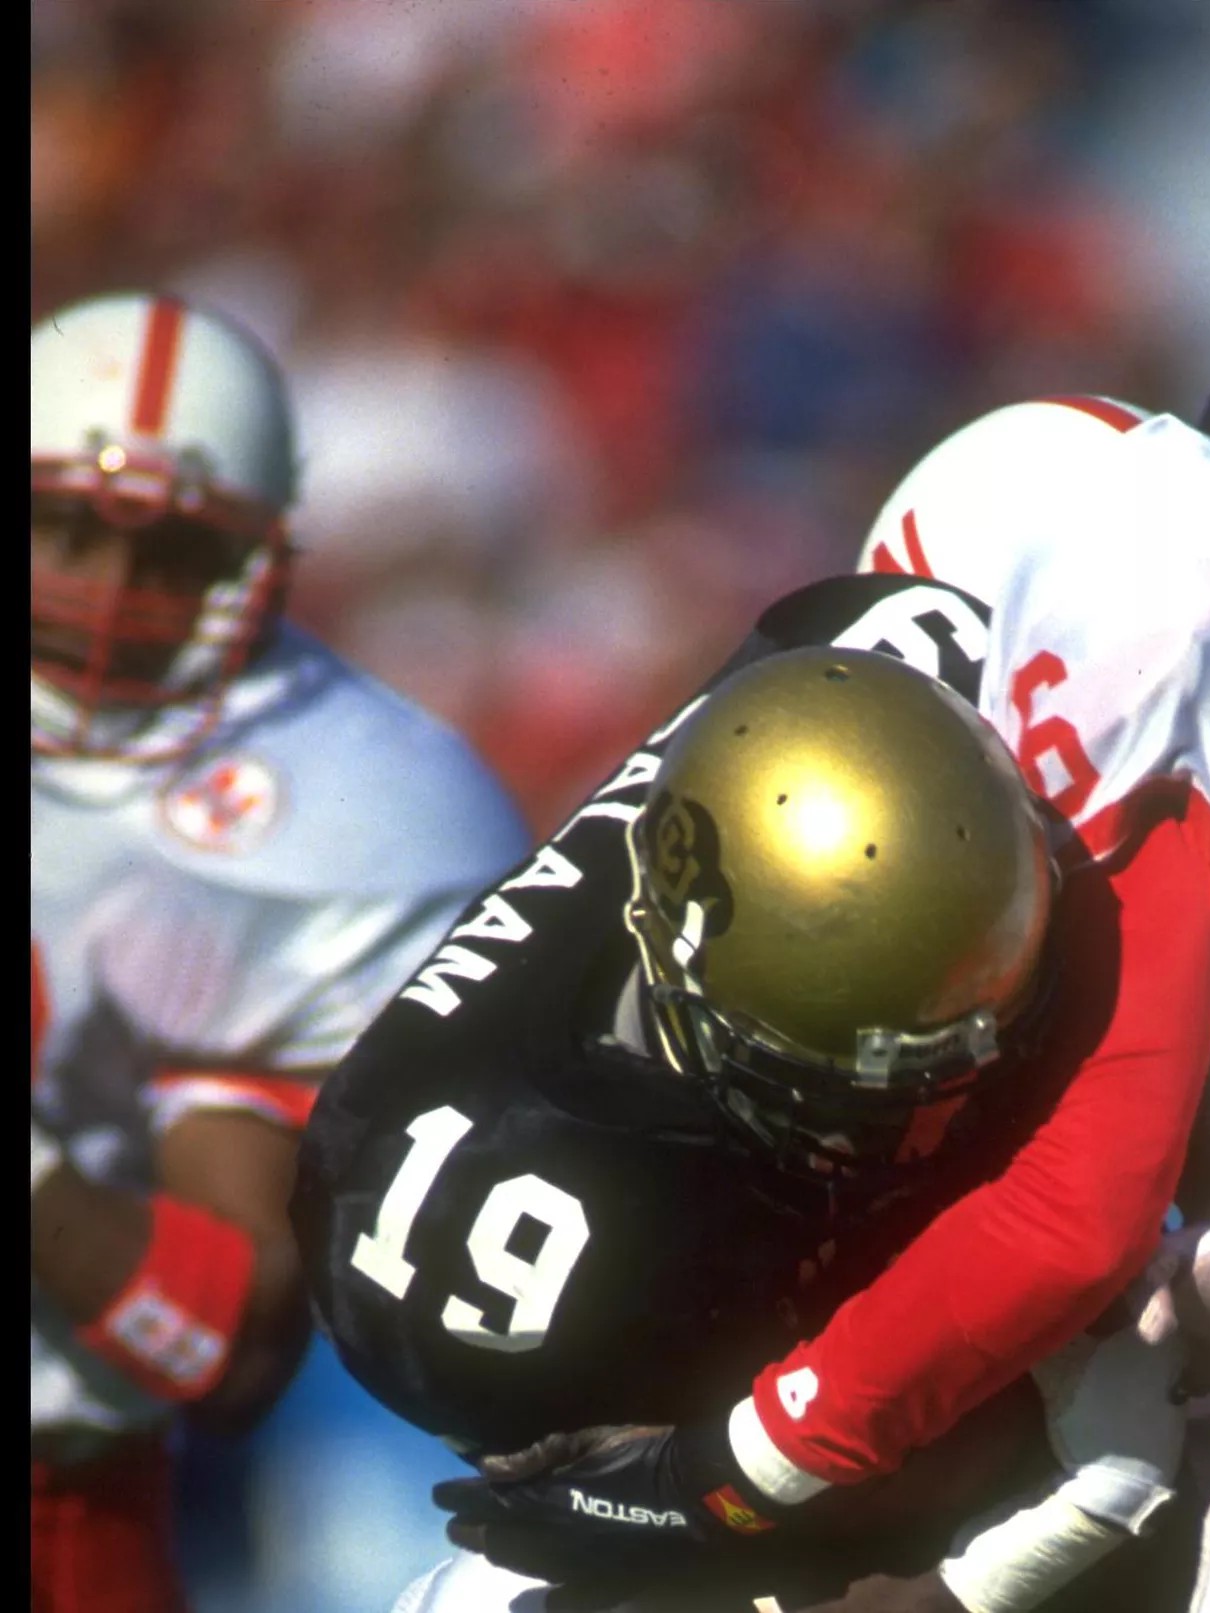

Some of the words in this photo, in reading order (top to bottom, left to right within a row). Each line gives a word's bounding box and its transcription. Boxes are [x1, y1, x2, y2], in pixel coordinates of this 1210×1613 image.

[1010, 650, 1102, 819] 6
[400, 692, 711, 1017] ALAAM
[350, 1105, 591, 1352] 19
[570, 1488, 687, 1528] EASTON
